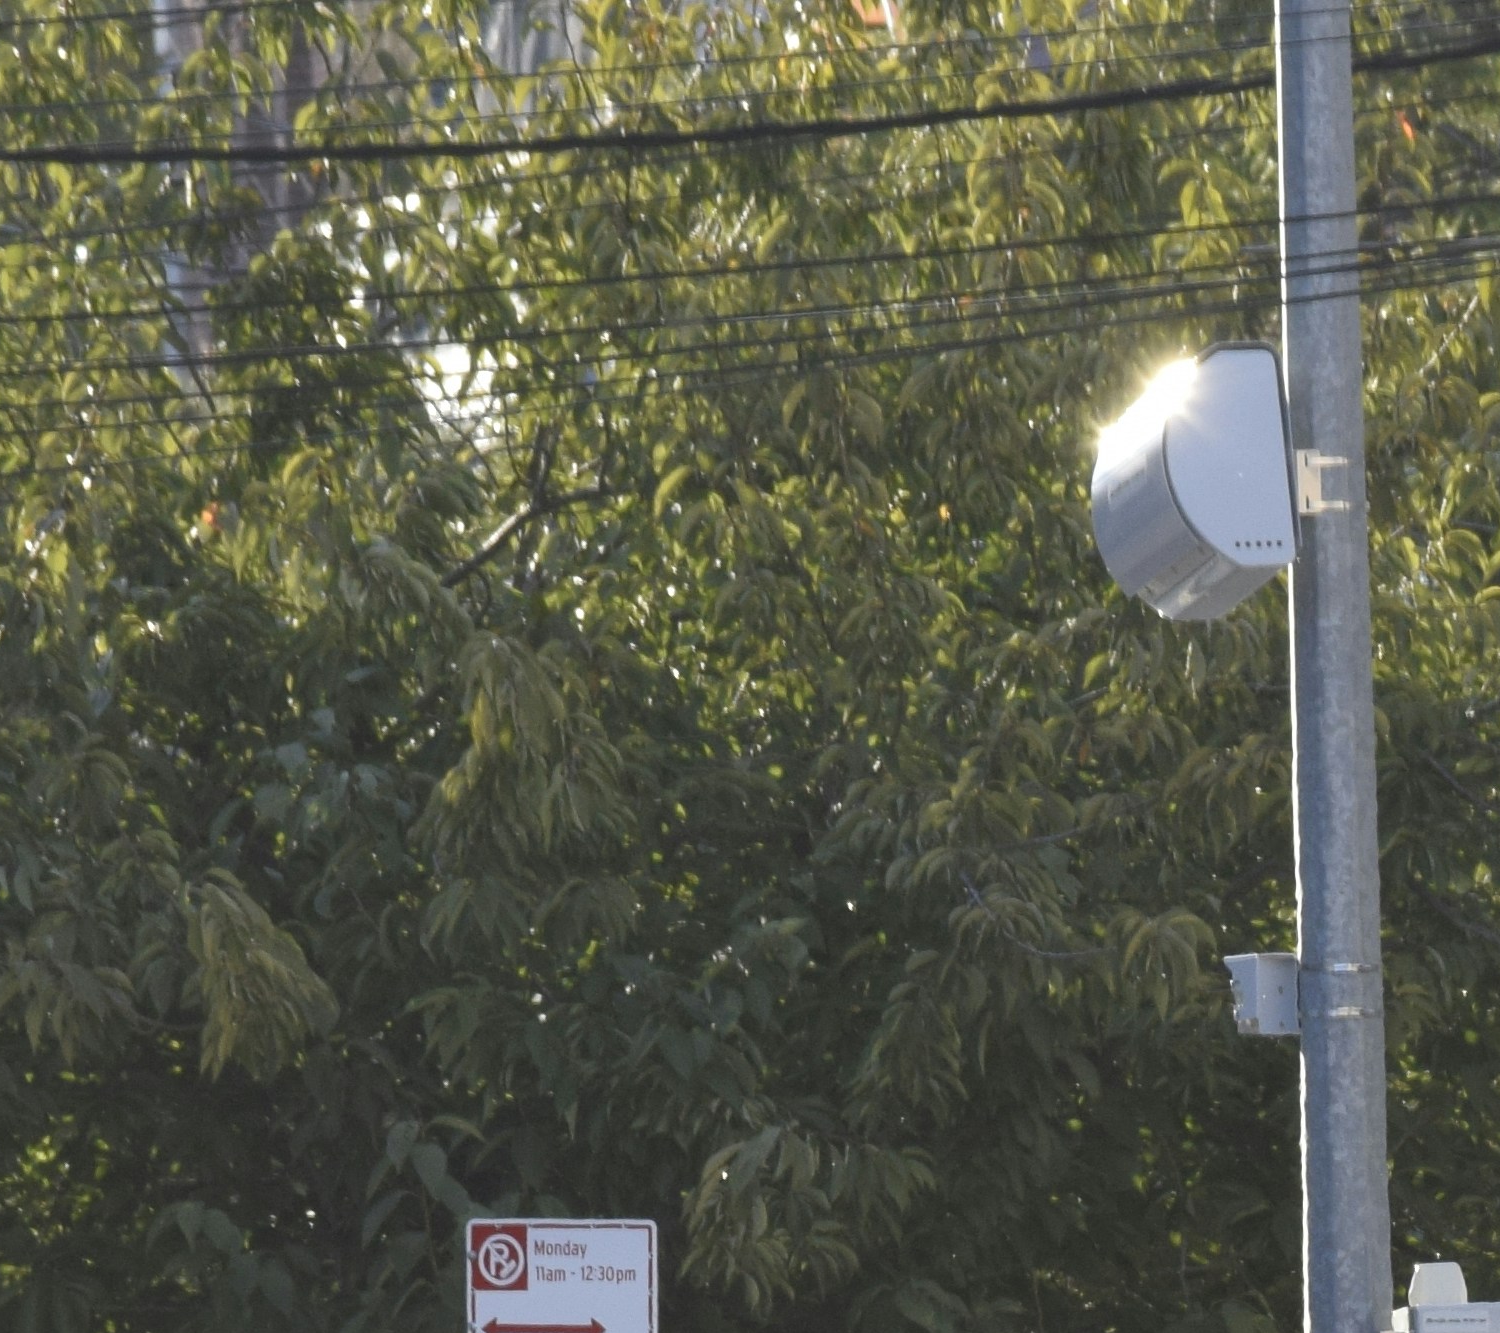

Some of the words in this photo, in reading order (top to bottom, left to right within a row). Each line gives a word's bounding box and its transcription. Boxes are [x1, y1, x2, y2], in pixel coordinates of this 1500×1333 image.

[533, 1240, 588, 1258] Monday
[535, 1266, 566, 1282] 11am
[580, 1265, 637, 1284] 12:30pm
